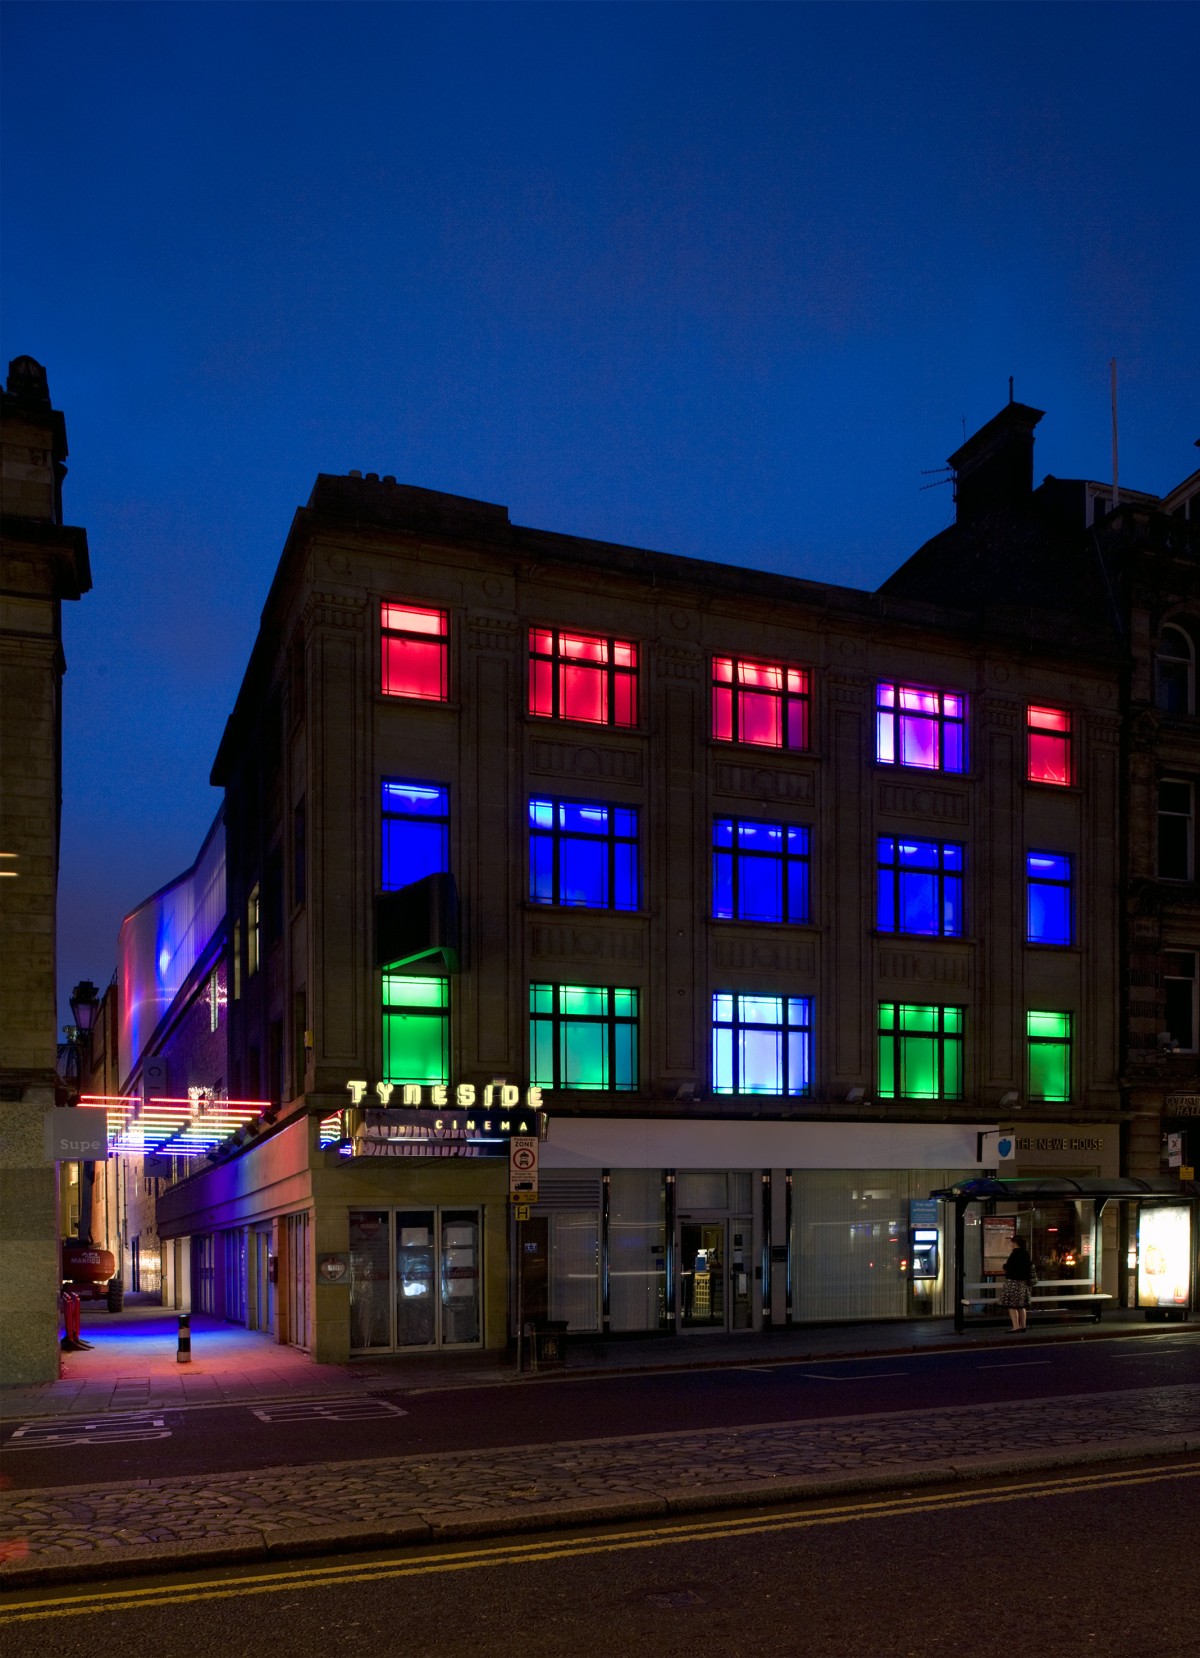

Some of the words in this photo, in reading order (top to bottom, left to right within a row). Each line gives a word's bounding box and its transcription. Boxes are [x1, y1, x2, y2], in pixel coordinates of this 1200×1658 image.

[347, 1080, 544, 1108] TYNESIDE
[435, 1119, 528, 1131] CINEMA
[1016, 1138, 1034, 1150] THE
[1037, 1138, 1069, 1150] NEWE
[1071, 1138, 1104, 1151] HOUSE
